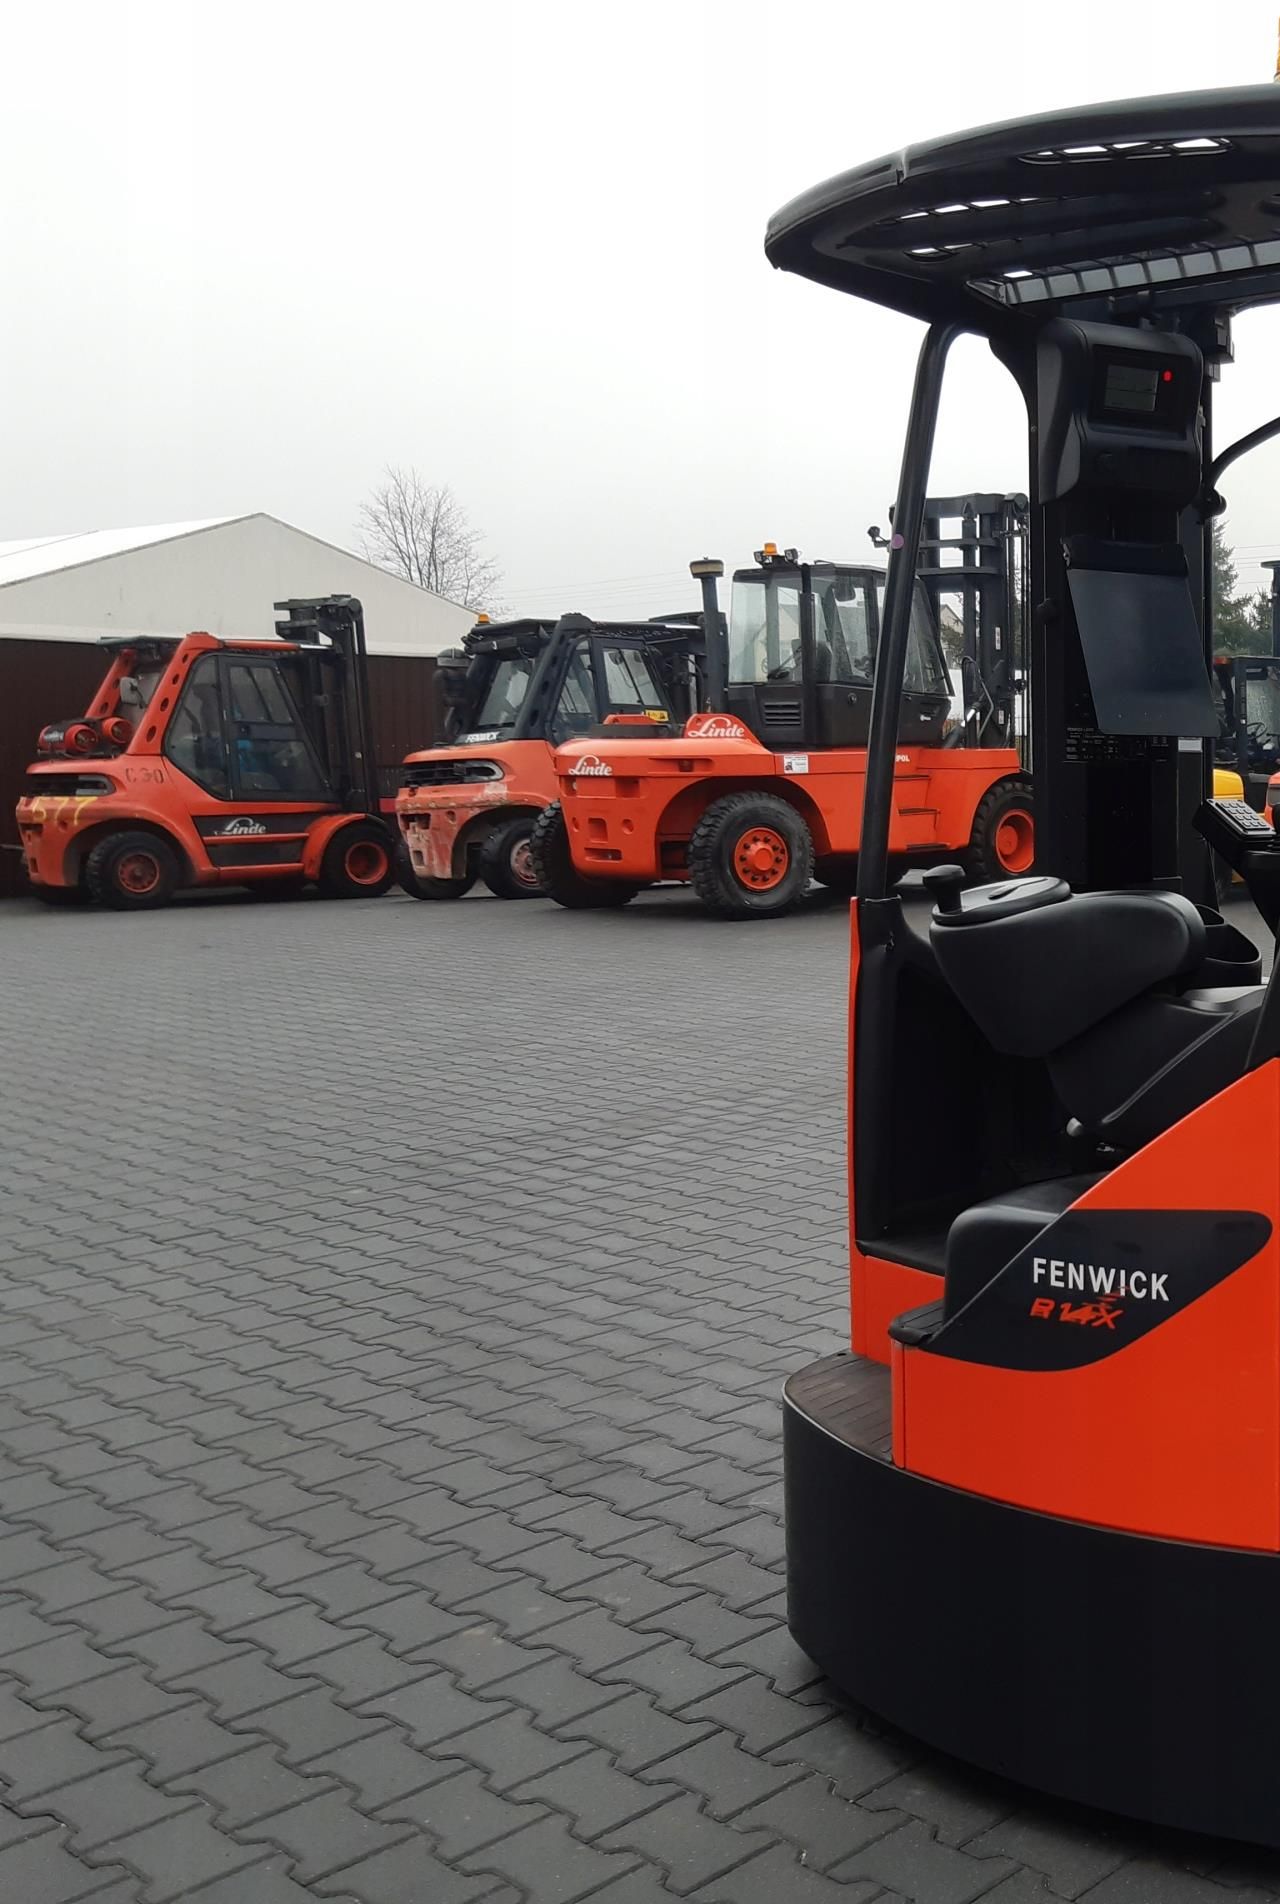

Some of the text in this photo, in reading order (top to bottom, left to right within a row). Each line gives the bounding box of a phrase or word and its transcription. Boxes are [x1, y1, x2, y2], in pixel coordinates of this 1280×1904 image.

[687, 716, 745, 737] Linde
[567, 754, 613, 776] Linde
[213, 816, 267, 835] Linde
[1033, 1256, 1170, 1302] FENWICK
